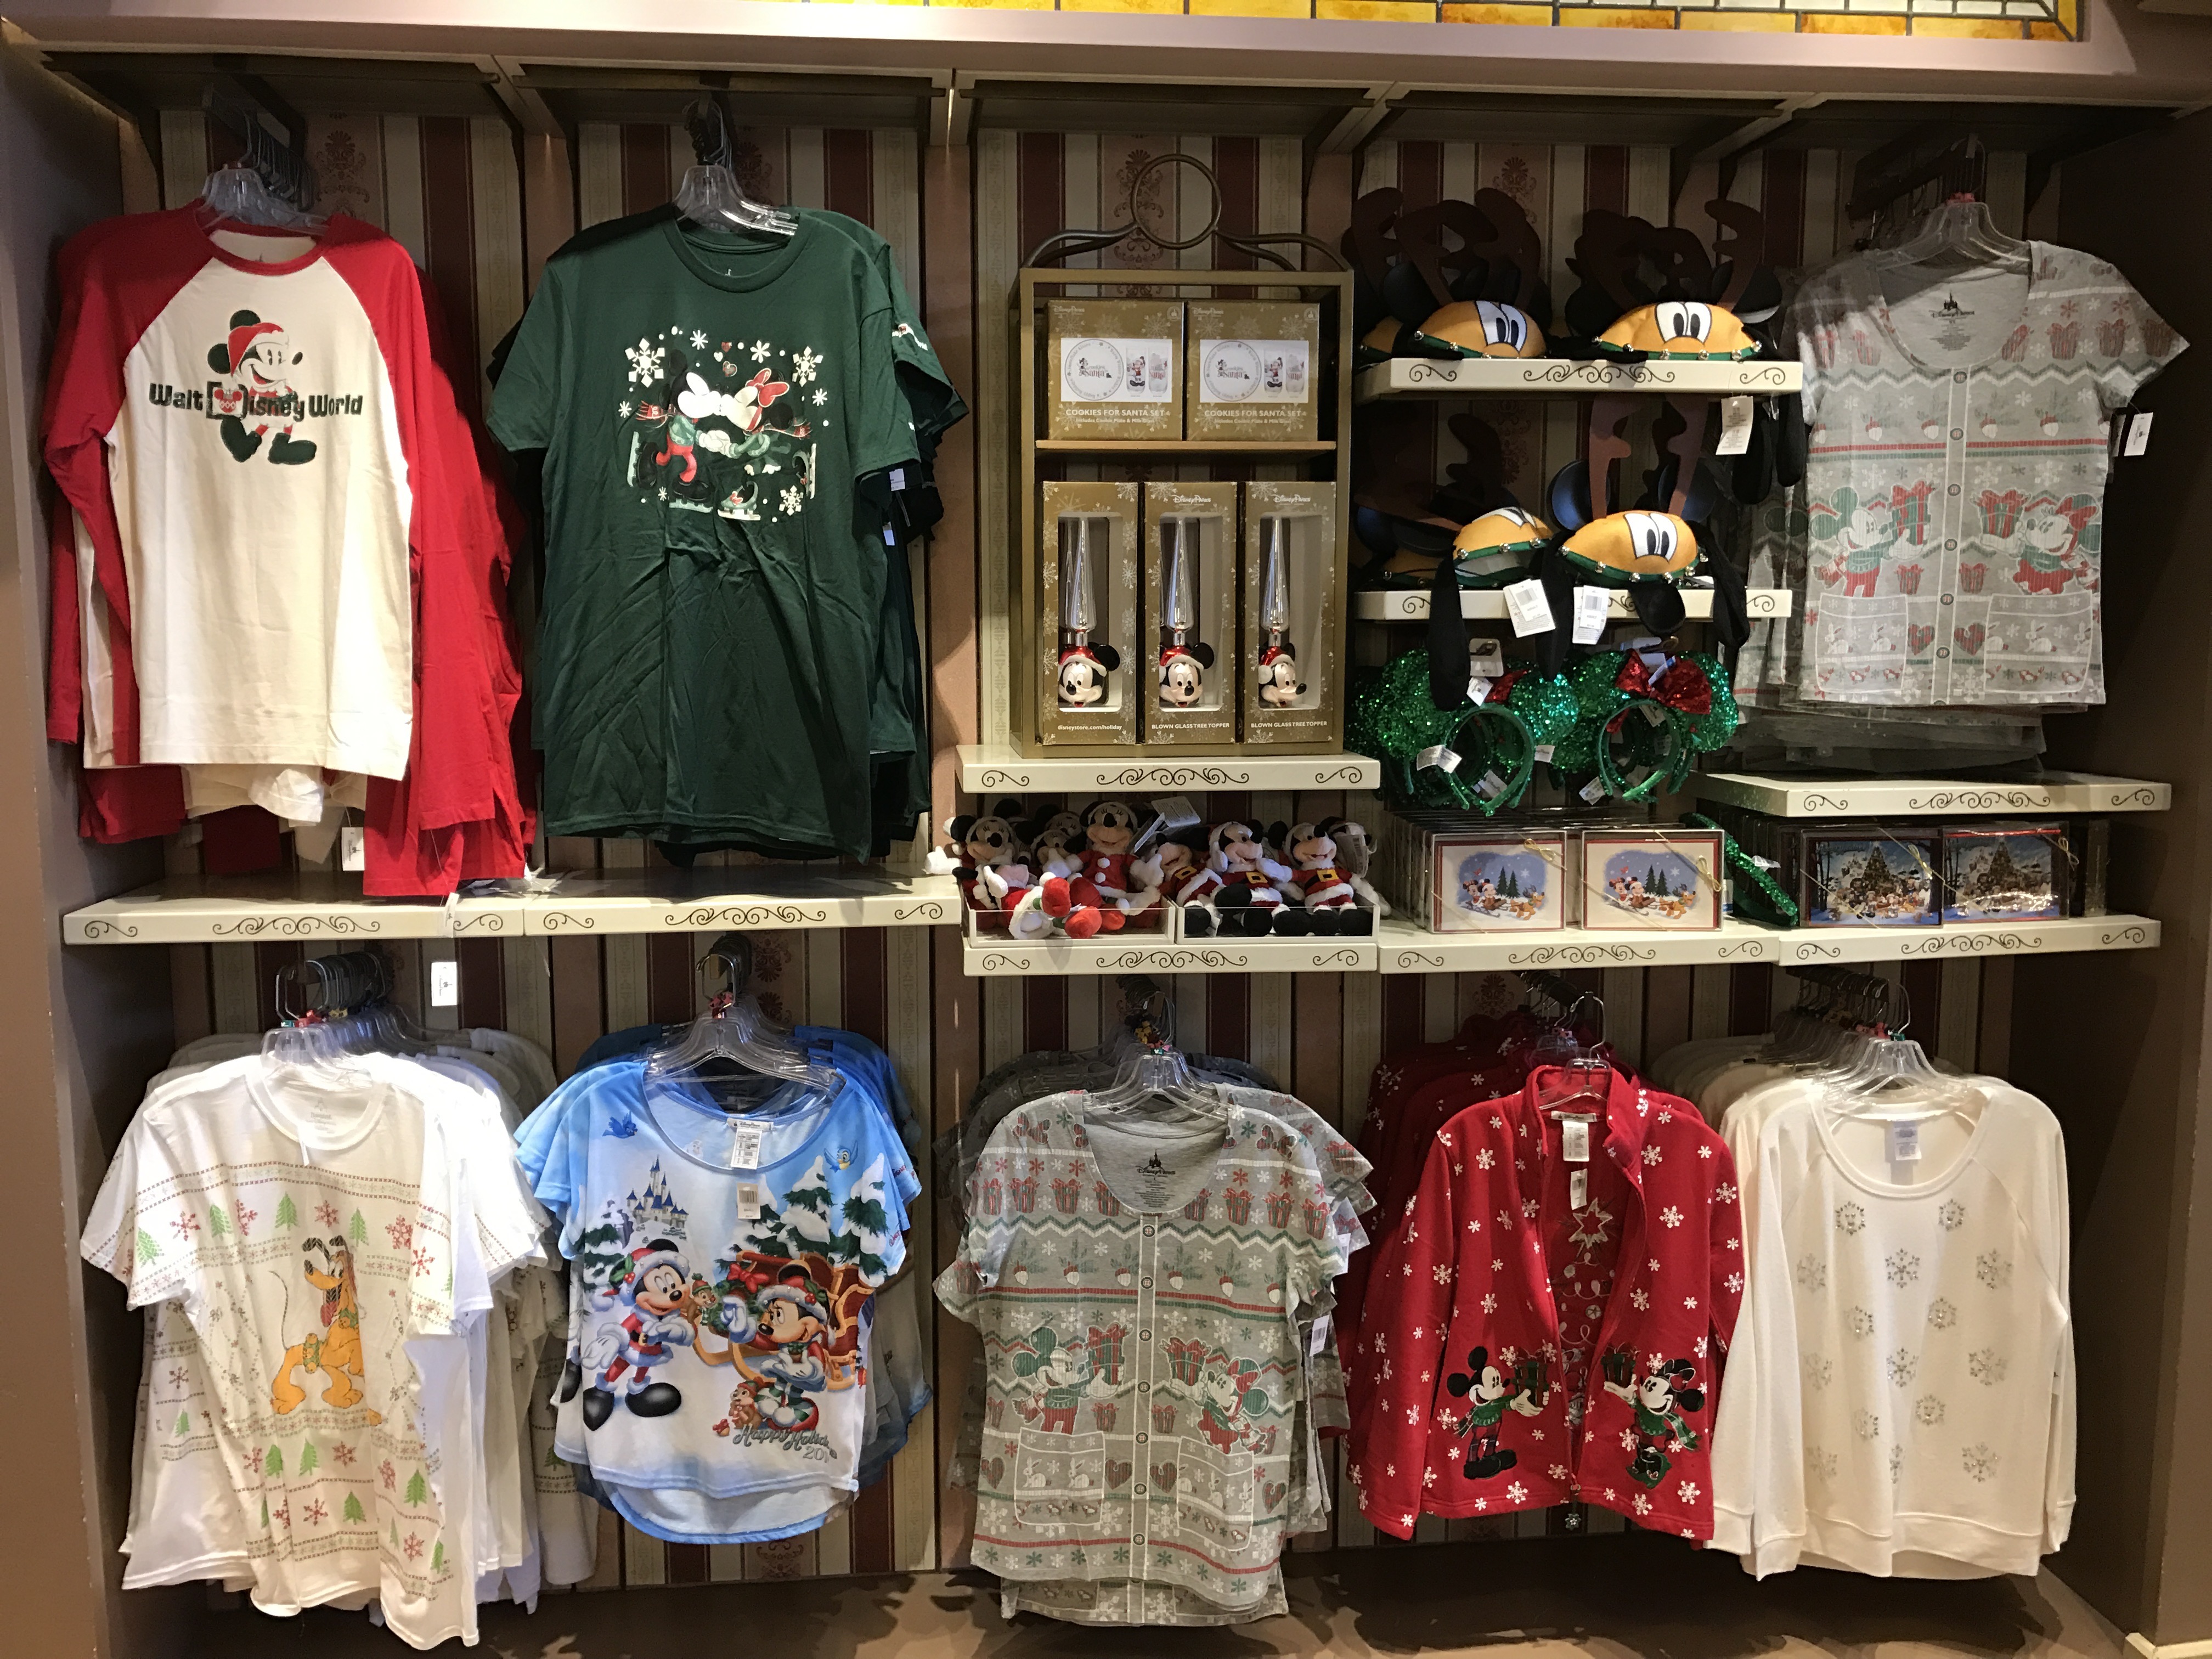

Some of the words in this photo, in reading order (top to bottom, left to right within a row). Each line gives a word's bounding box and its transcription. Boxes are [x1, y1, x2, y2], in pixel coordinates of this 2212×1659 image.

[149, 382, 203, 411] Walt
[308, 394, 363, 418] World
[732, 1423, 791, 1447] Happy
[803, 1446, 830, 1463] 201
